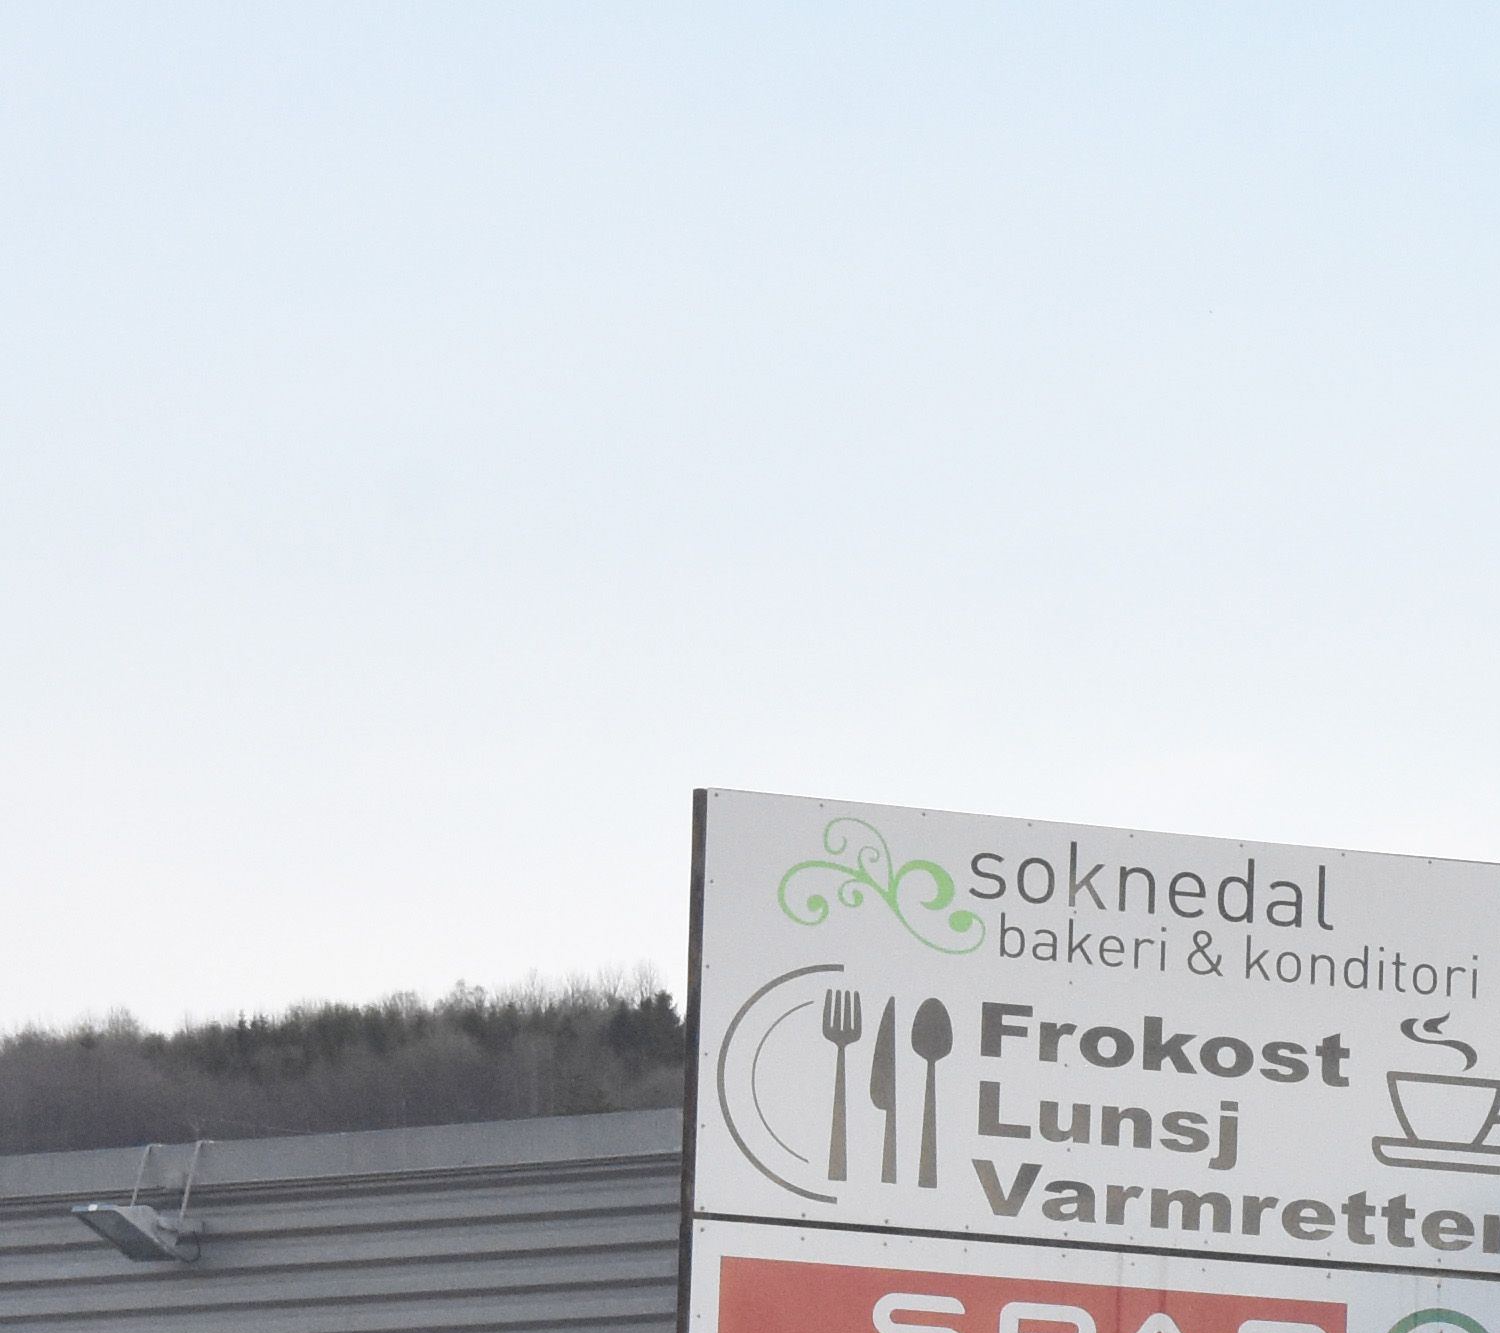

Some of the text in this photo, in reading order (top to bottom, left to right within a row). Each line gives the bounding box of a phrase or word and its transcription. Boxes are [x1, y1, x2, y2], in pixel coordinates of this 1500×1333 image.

[969, 842, 1334, 930] soknedal
[999, 918, 1478, 999] bakeri & konditori
[980, 1002, 1350, 1088] Frokost
[979, 1082, 1240, 1171] Lunsj
